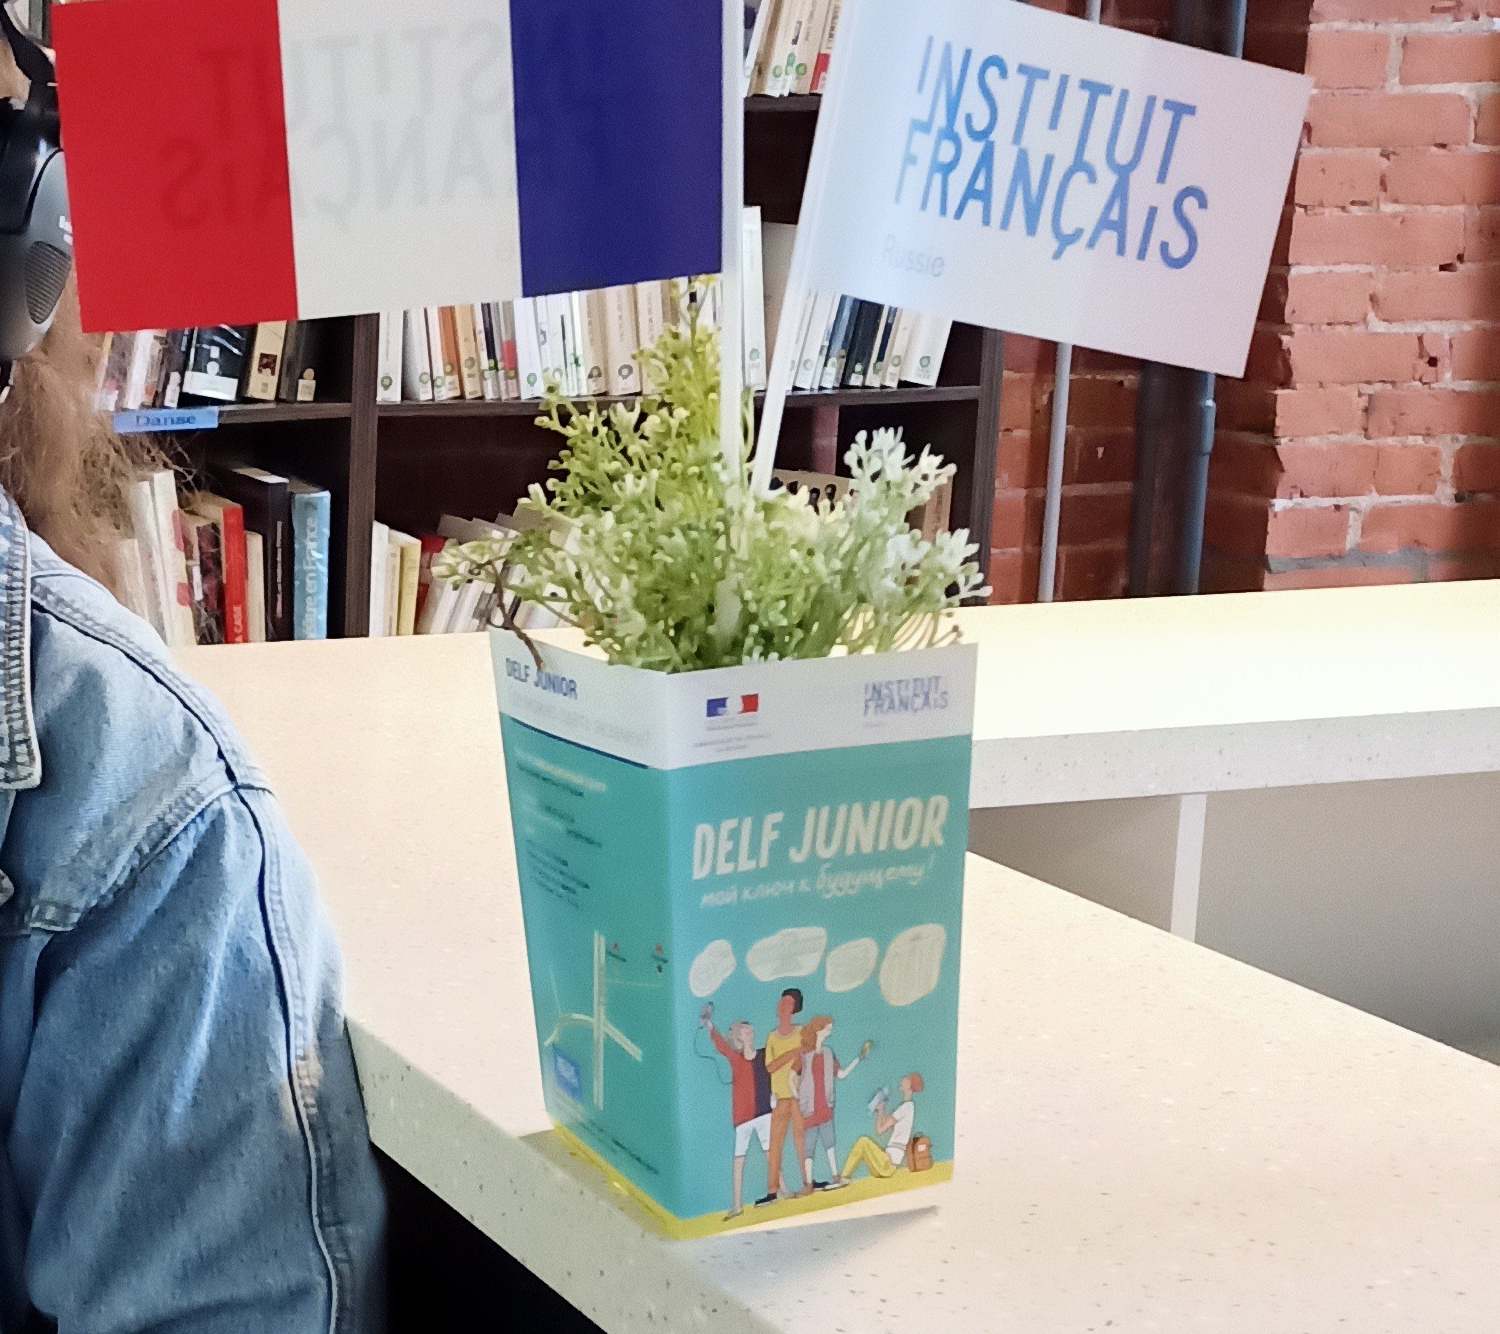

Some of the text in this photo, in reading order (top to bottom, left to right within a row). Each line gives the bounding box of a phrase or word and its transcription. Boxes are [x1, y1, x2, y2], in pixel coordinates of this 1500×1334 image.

[917, 34, 1197, 186] INSTITUT
[894, 118, 1209, 271] FRANÇAIS
[136, 414, 197, 427] Danse
[302, 516, 318, 570] France
[505, 657, 578, 701] DELF JUNIOR
[863, 675, 942, 700] INSTITUT
[691, 809, 785, 881] DELF
[788, 793, 950, 865] JUNIOR
